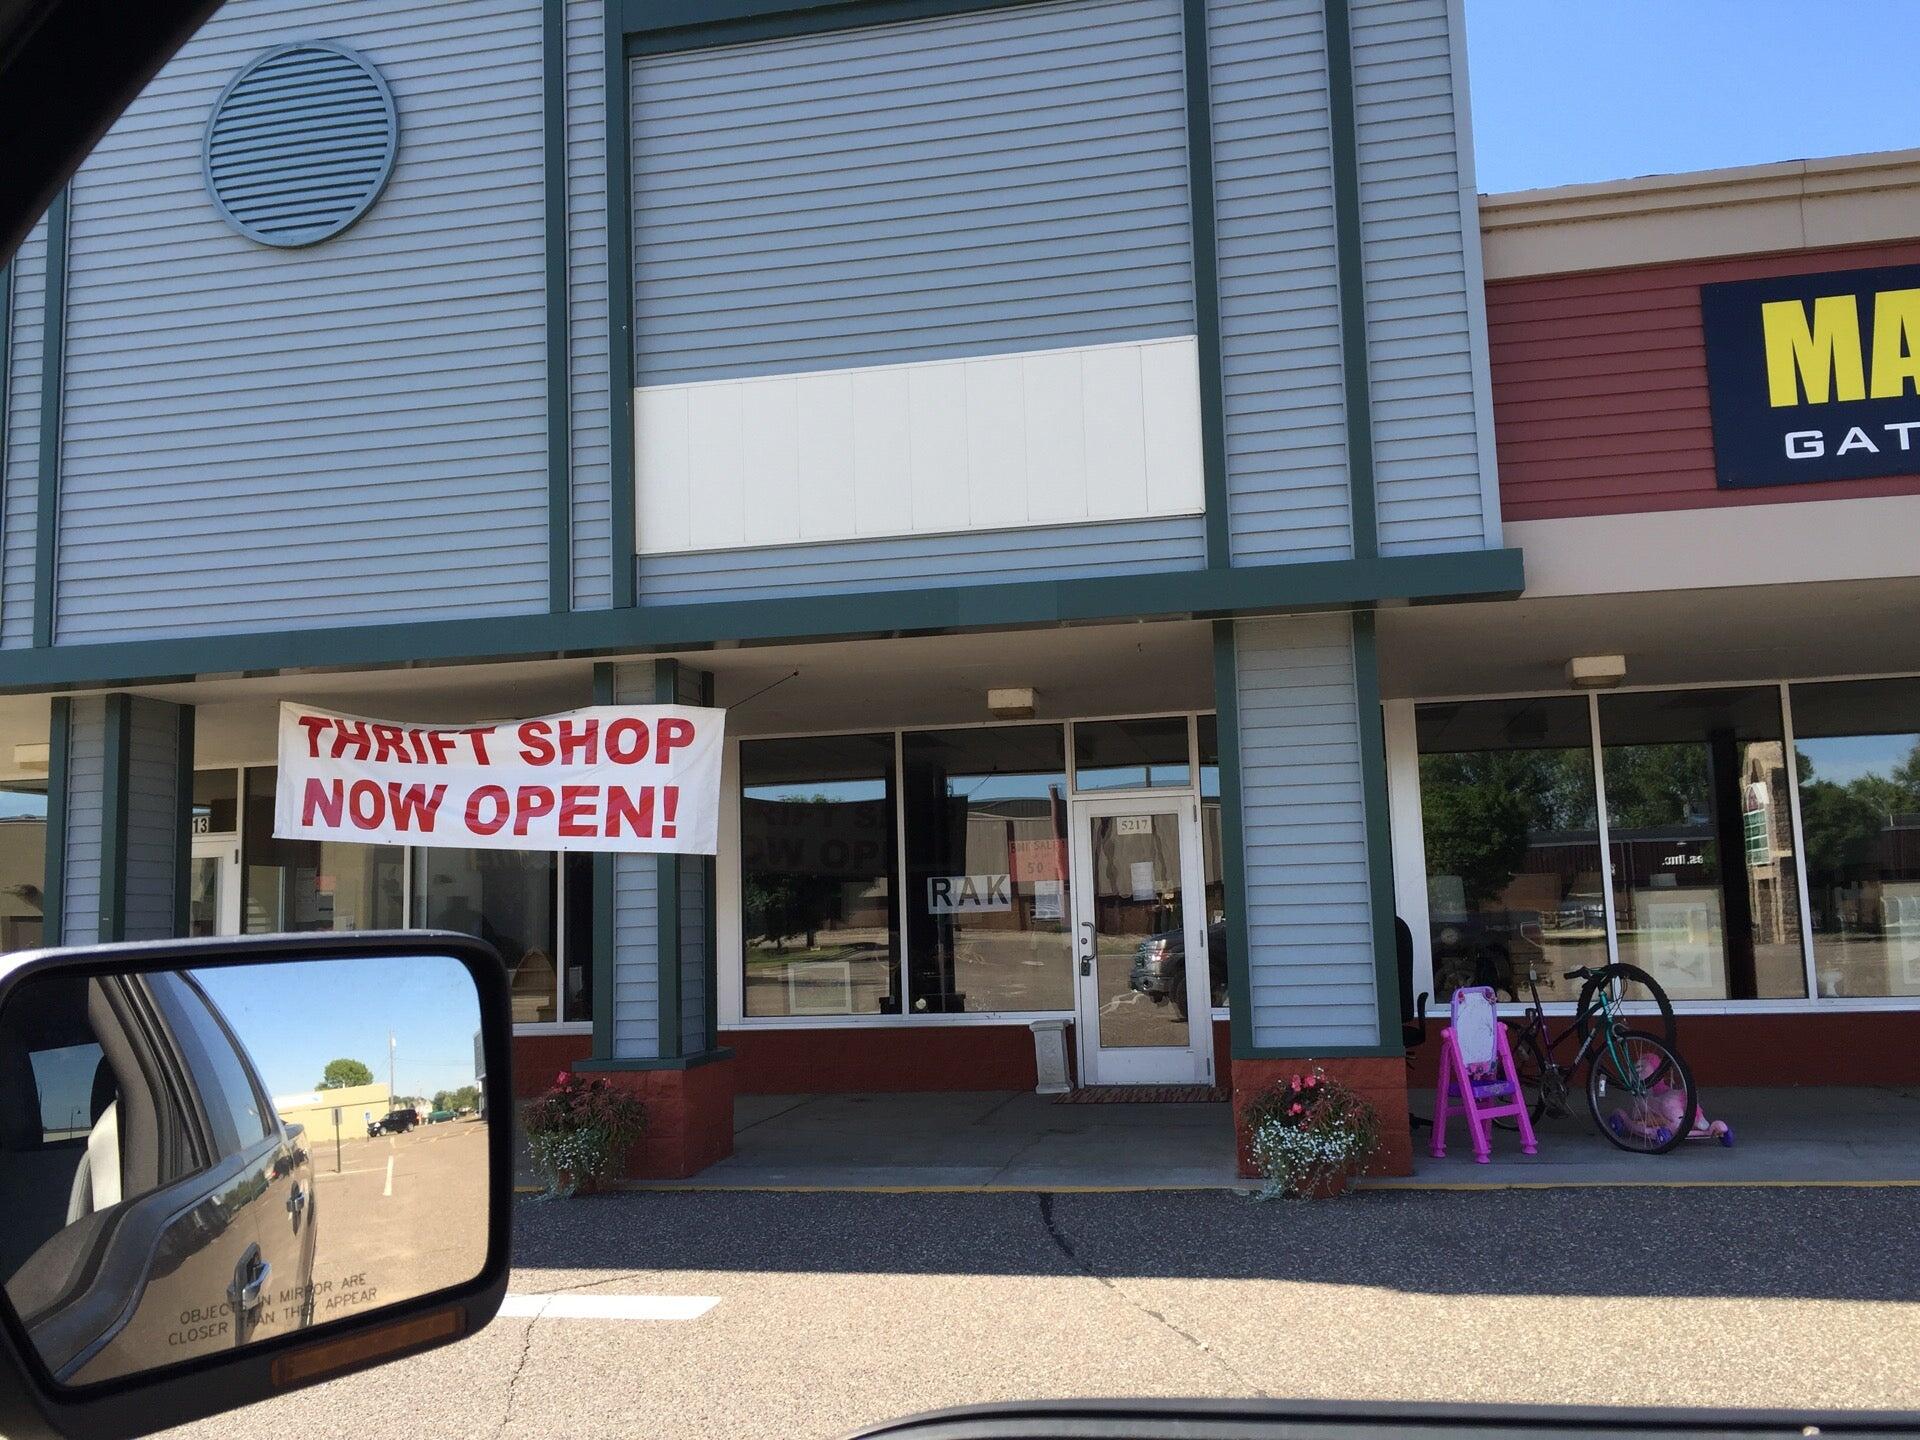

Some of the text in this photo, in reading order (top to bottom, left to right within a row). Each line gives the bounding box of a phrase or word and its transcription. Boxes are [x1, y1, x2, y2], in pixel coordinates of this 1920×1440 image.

[1762, 288, 1920, 408] MA
[1784, 422, 1920, 460] GAT
[298, 715, 695, 766] THRIFT SHOP
[301, 777, 680, 839] NOW OPEN!
[1121, 819, 1148, 831] 5217
[931, 876, 1009, 907] RAK
[279, 1280, 333, 1303] MIRROR
[341, 1273, 367, 1290] ARE
[168, 1322, 228, 1346] CLOSER
[326, 1288, 377, 1311] APPEAR
